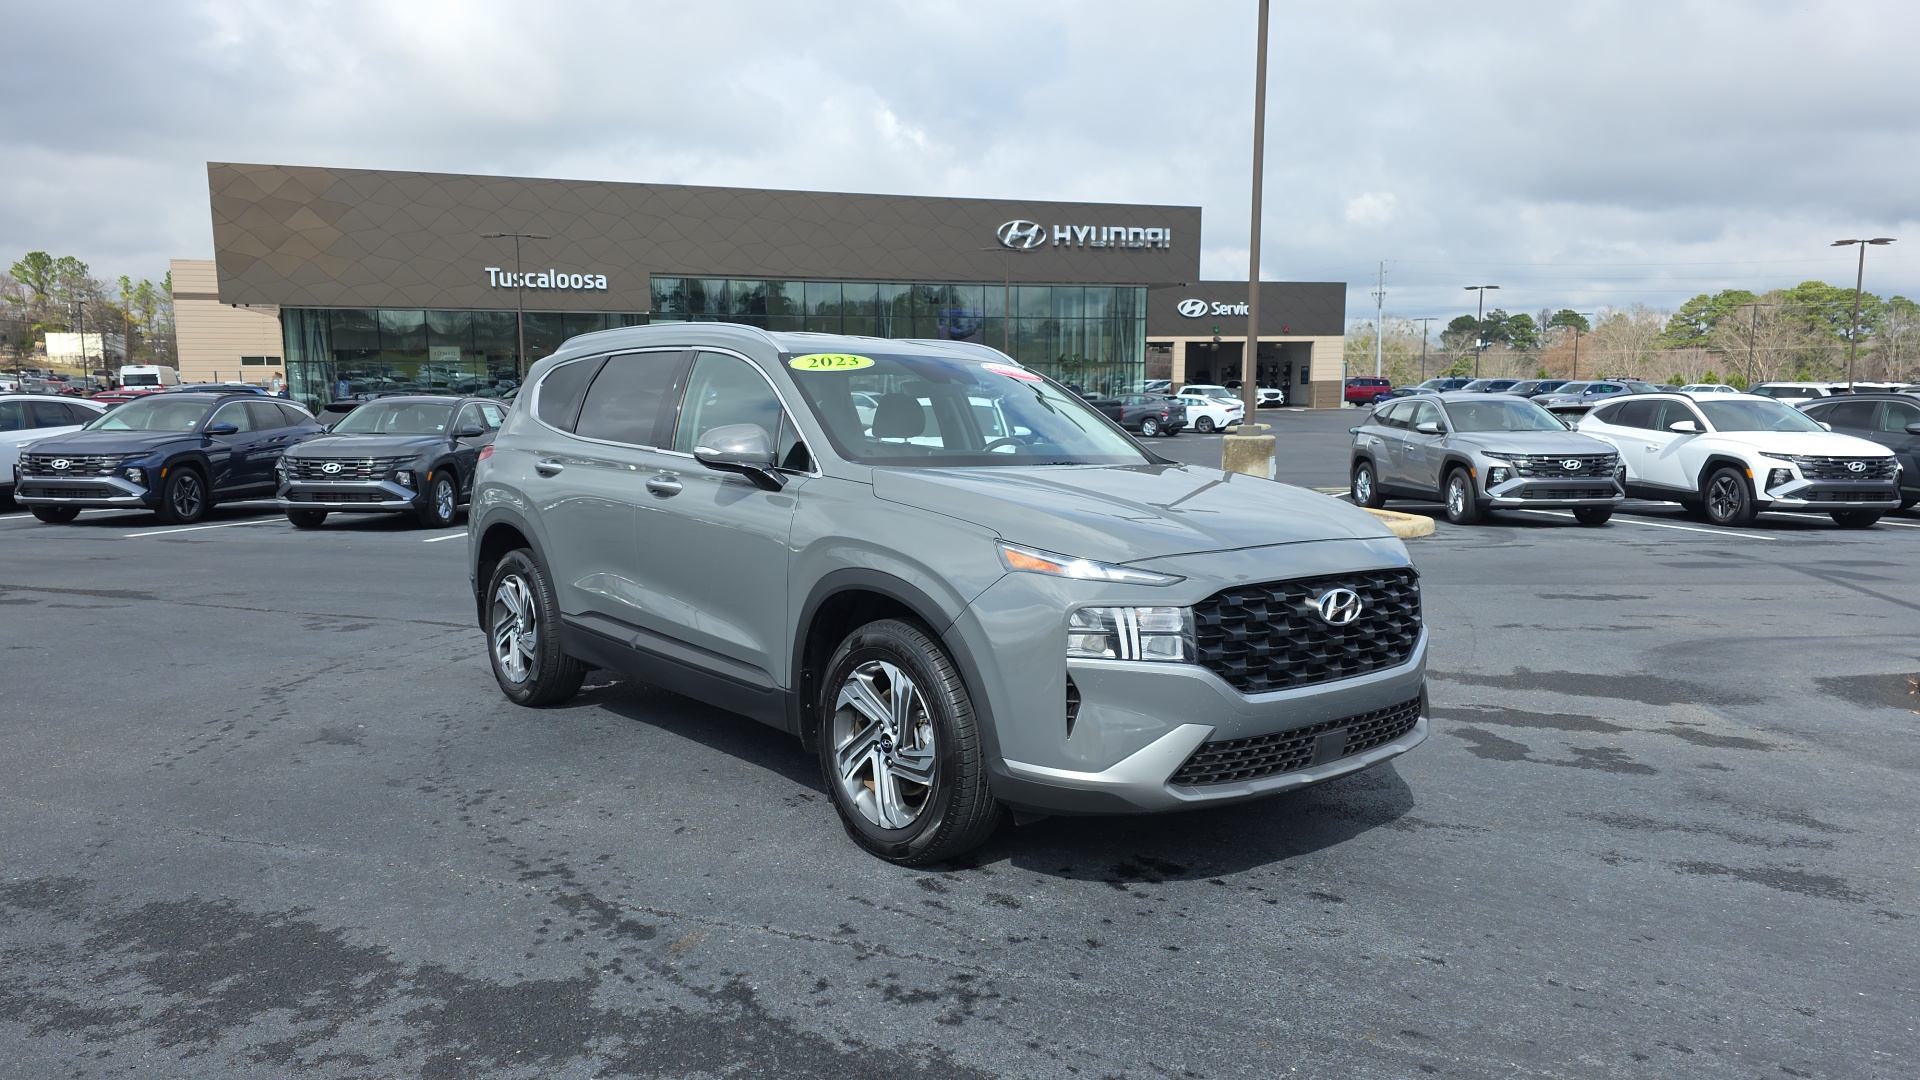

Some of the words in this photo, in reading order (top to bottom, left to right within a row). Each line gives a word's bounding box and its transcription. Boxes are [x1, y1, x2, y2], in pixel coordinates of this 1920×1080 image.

[1053, 225, 1171, 249] HYUNDAI
[484, 267, 607, 289] Tuscaloosa
[1210, 301, 1250, 316] Servic
[807, 356, 859, 368] 2023
